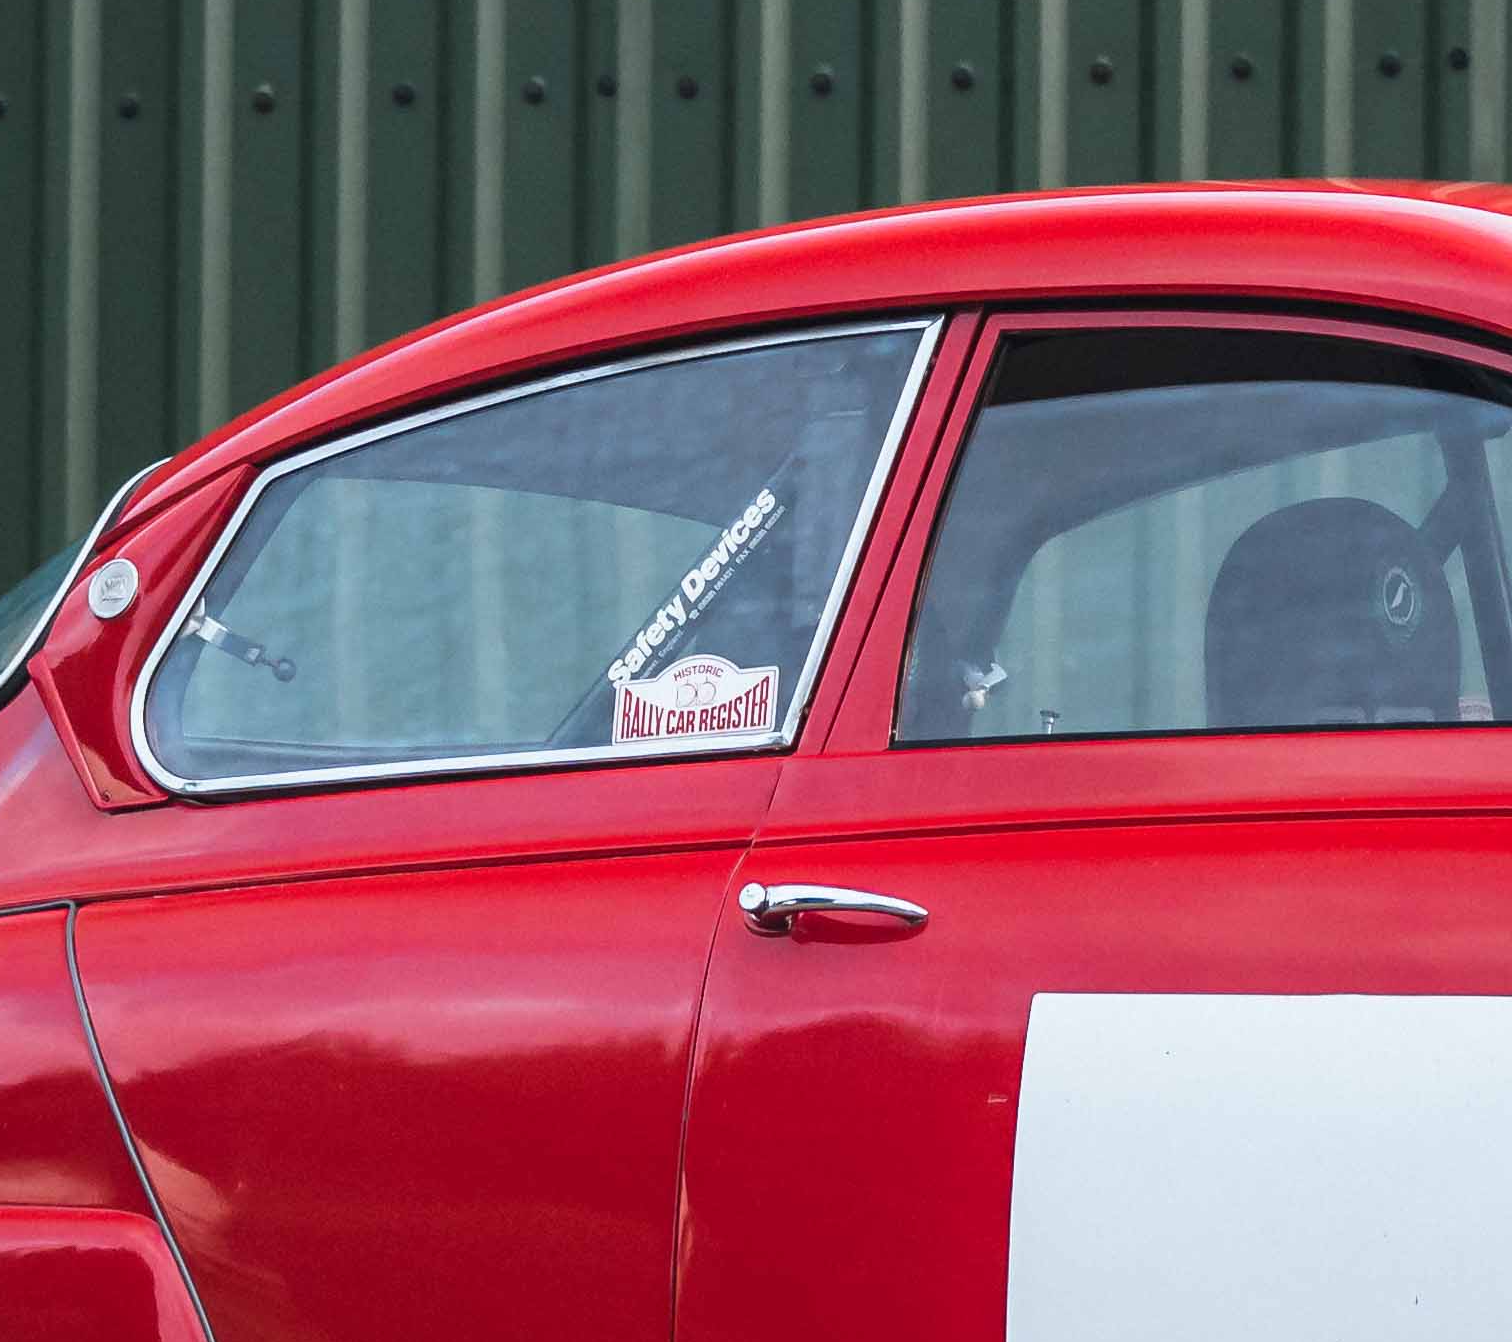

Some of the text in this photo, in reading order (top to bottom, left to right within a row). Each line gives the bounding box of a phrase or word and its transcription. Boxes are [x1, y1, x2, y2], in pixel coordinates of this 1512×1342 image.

[608, 488, 776, 684] Safety Devices
[673, 664, 725, 682] HISTORIC
[620, 675, 771, 740] RALLY CAR REGISTER
